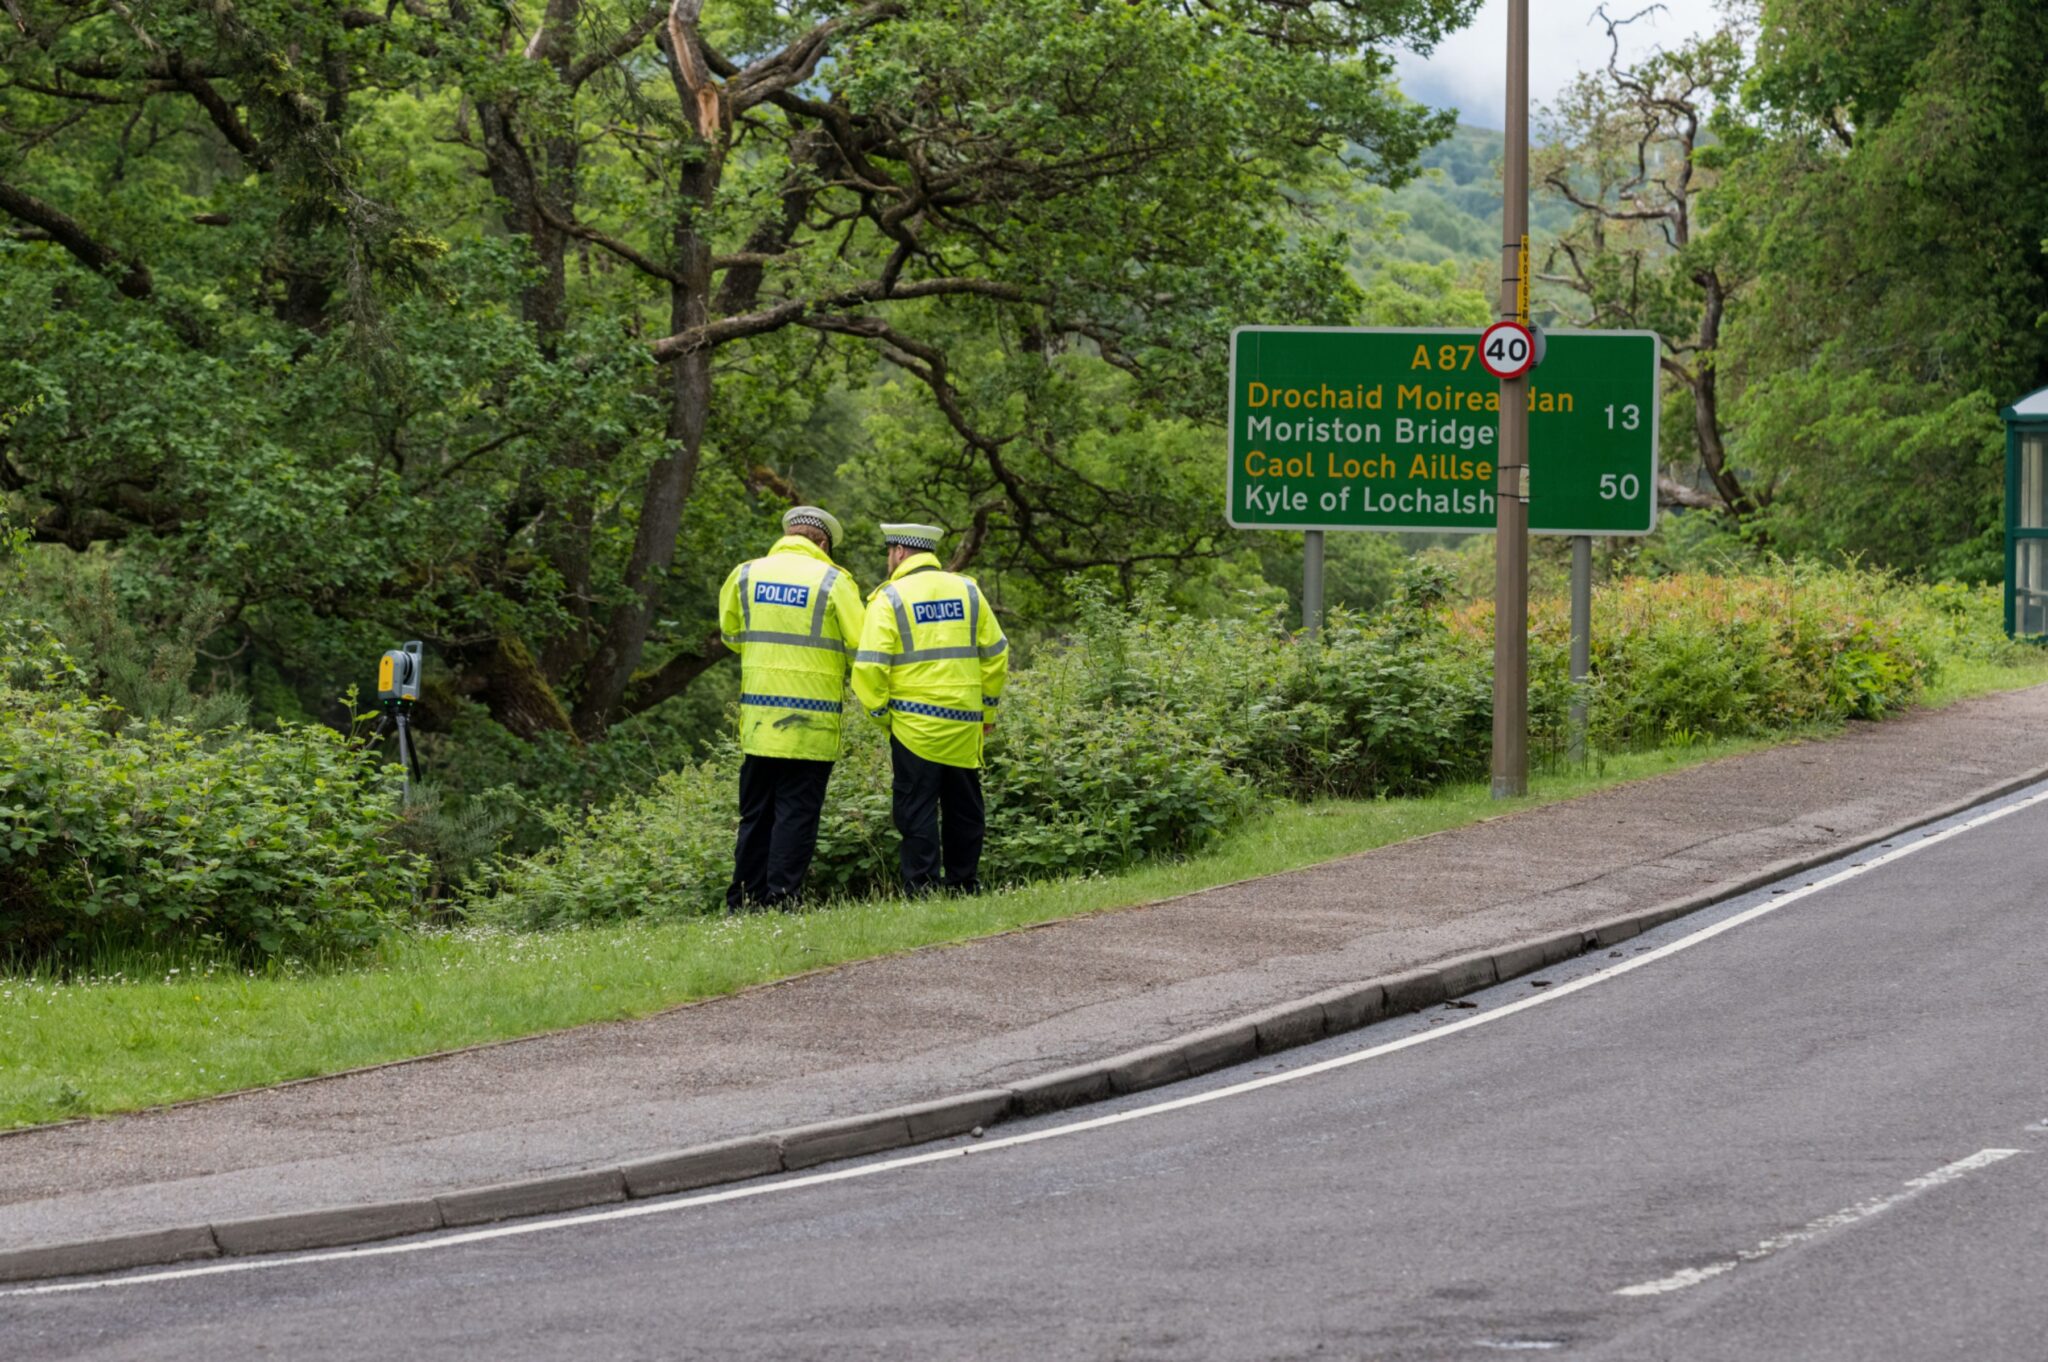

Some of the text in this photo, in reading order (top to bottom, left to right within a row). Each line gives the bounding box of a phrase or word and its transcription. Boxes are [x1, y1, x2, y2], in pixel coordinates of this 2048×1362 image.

[1486, 338, 1528, 361] 40
[1247, 382, 1573, 412] Drochaid Moireadan
[1247, 416, 1381, 444] Moriston
[1605, 404, 1640, 430] 13
[1245, 450, 1493, 481] Caol Loch Aillse
[1245, 484, 1495, 516] Kyle of Lochalsh
[1599, 473, 1640, 500] 50
[756, 584, 807, 605] POLICE
[915, 601, 963, 621] POLICE
